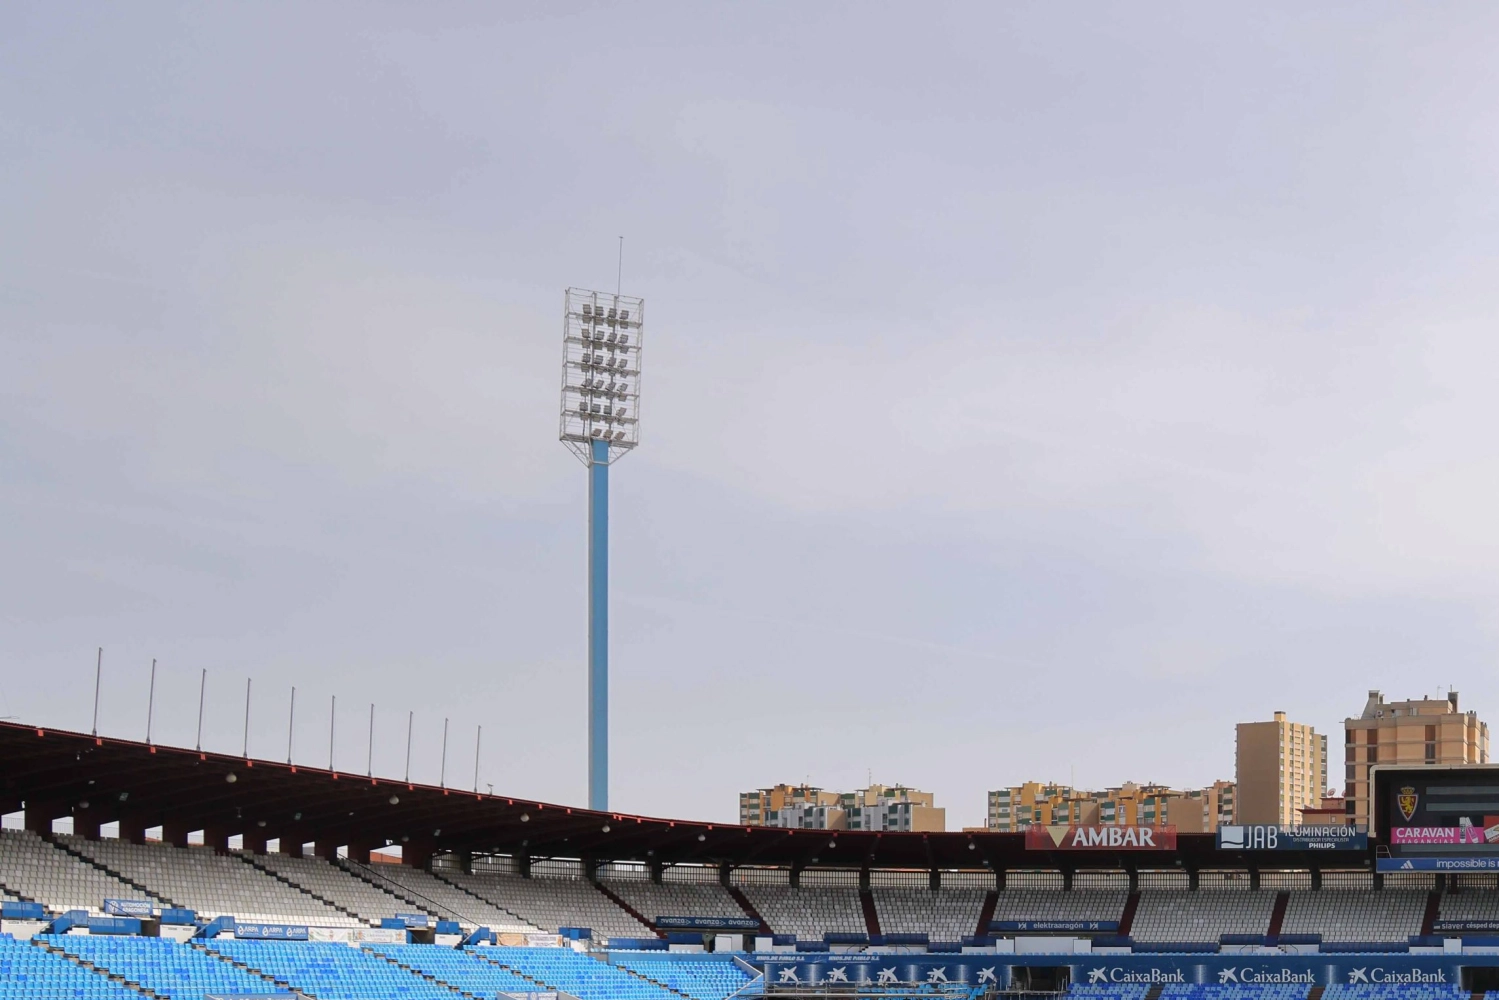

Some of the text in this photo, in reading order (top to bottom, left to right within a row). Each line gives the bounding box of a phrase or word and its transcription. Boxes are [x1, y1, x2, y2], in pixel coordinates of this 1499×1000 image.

[1072, 827, 1156, 846] AMBAR
[1246, 825, 1356, 849] JAB ILUMINACIÓN
[1396, 828, 1454, 838] CARAVAN
[1436, 859, 1486, 869] impossible
[1488, 859, 1496, 867] is
[1441, 922, 1464, 930] siaver
[1110, 967, 1185, 983] CaixaBank
[1240, 967, 1316, 983] CaixaBank
[1370, 967, 1447, 983] CaixaBank
